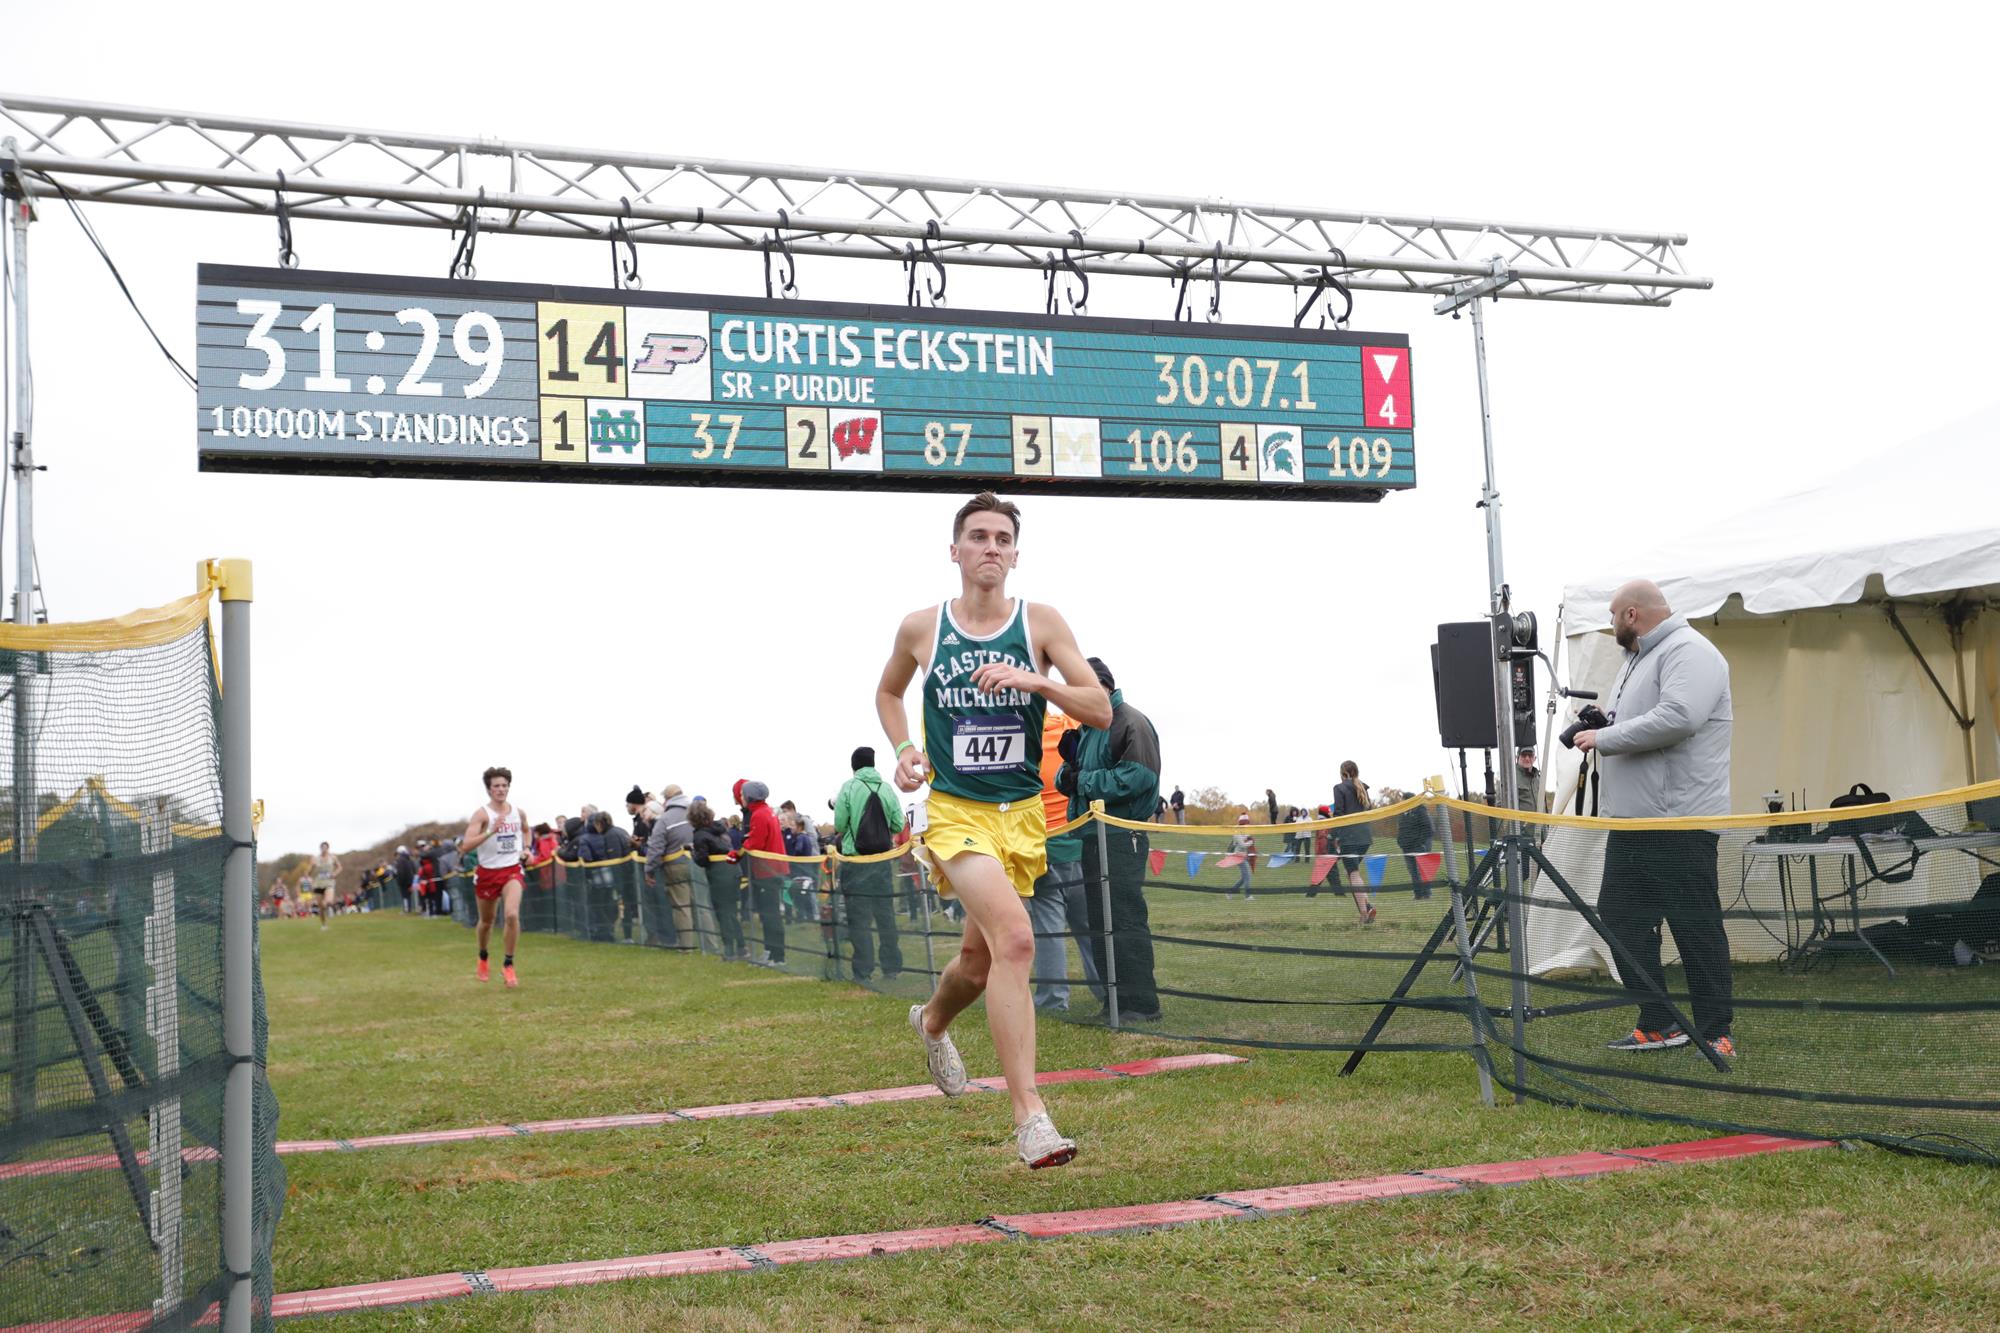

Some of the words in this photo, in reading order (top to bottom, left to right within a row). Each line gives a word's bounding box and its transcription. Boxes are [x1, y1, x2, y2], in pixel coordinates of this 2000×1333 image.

[237, 299, 505, 399] 31:29
[545, 318, 624, 383] 14
[720, 319, 861, 367] CURTIS
[874, 327, 1054, 376] ECKSTEIN
[721, 371, 754, 399] SR
[775, 374, 876, 404] PURDUE
[1154, 355, 1317, 410] 30:07.1
[211, 405, 346, 440] 10000M
[355, 410, 530, 447] STANDINGS
[552, 410, 575, 451] 1
[1379, 394, 1398, 426] 4
[689, 413, 744, 460] 37
[796, 419, 817, 459] 2
[832, 417, 879, 462] W
[924, 421, 973, 467] 87
[1022, 427, 1042, 466] 3
[1126, 429, 1199, 474] 106
[1229, 435, 1250, 471] 4
[1327, 436, 1393, 480] 109
[936, 687, 1031, 708] MICHIGAN
[965, 735, 1013, 762] 447
